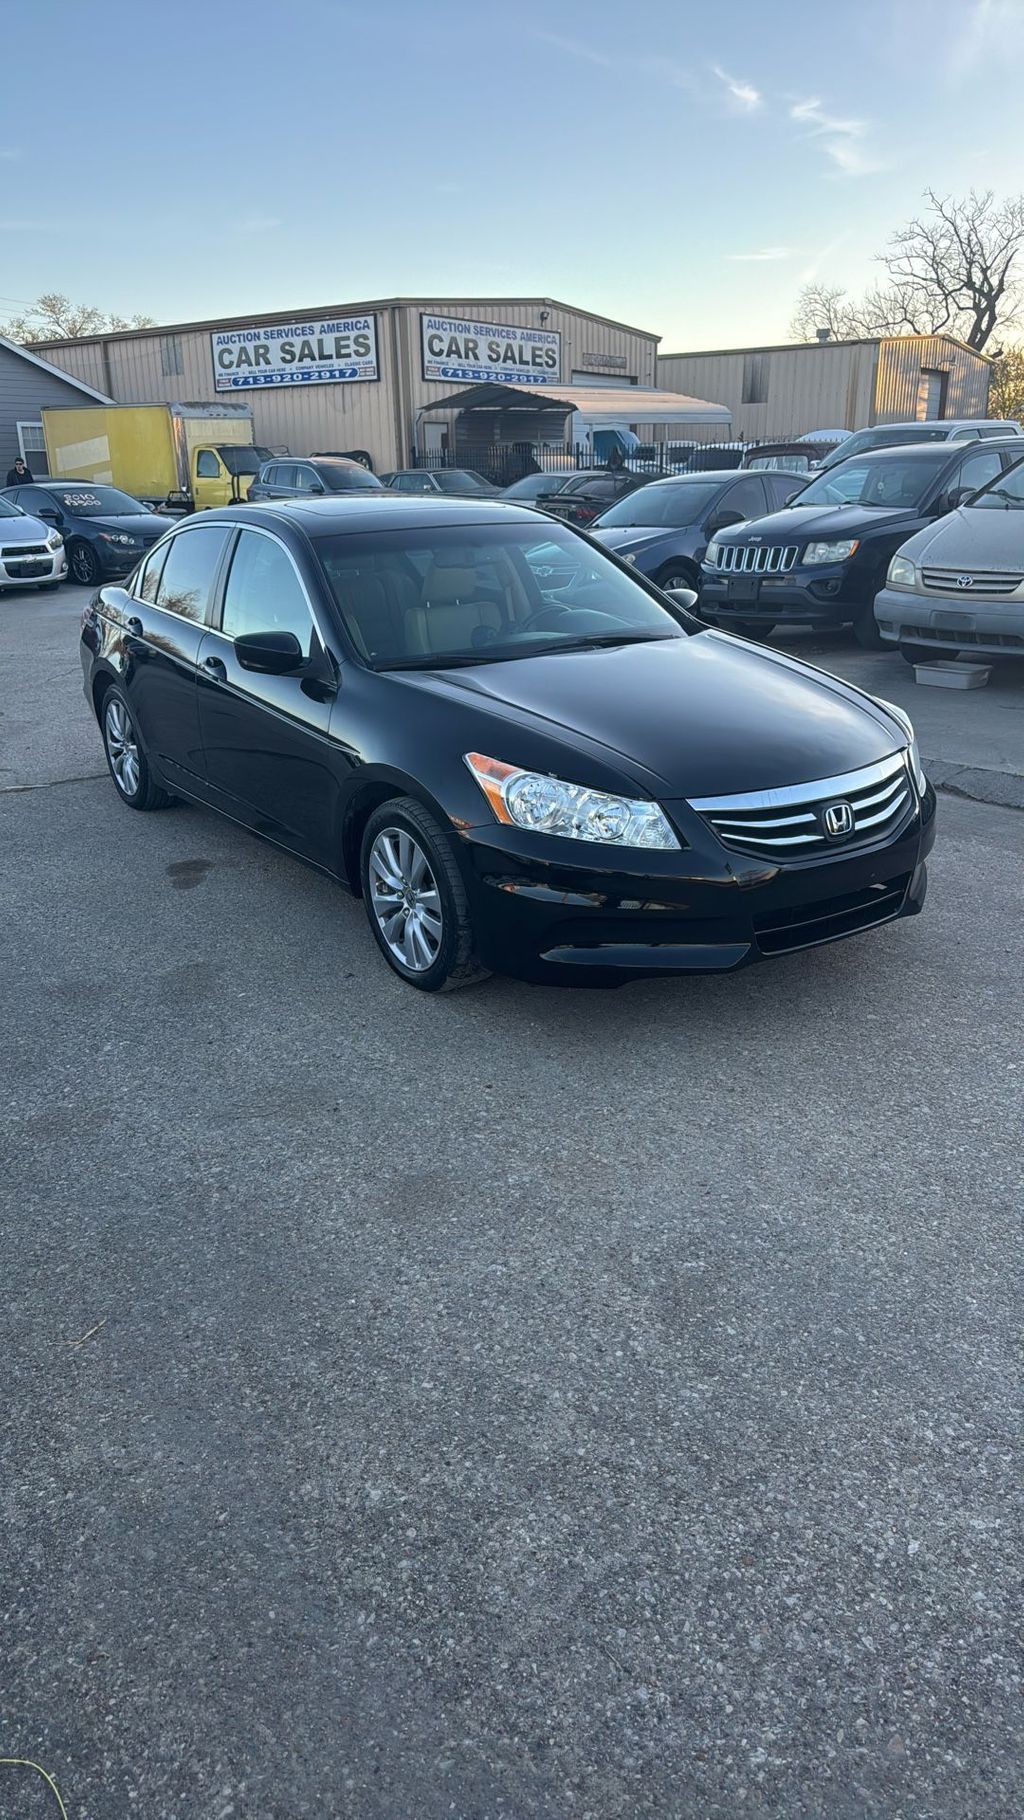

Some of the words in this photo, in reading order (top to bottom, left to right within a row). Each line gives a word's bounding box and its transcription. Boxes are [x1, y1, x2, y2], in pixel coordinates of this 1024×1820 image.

[216, 331, 261, 346] AUCTION
[263, 325, 315, 340] SERVICES
[319, 319, 370, 335] AMERICA
[427, 319, 471, 334] AUCTION
[473, 325, 517, 340] SERVICES
[520, 331, 557, 345] AMERICA
[218, 344, 272, 369] CAR
[280, 333, 371, 364] SALES
[428, 333, 480, 361] CAR
[487, 340, 557, 368] SALES
[236, 369, 353, 385] 713-920-2917
[445, 369, 544, 383] 713-920-2917
